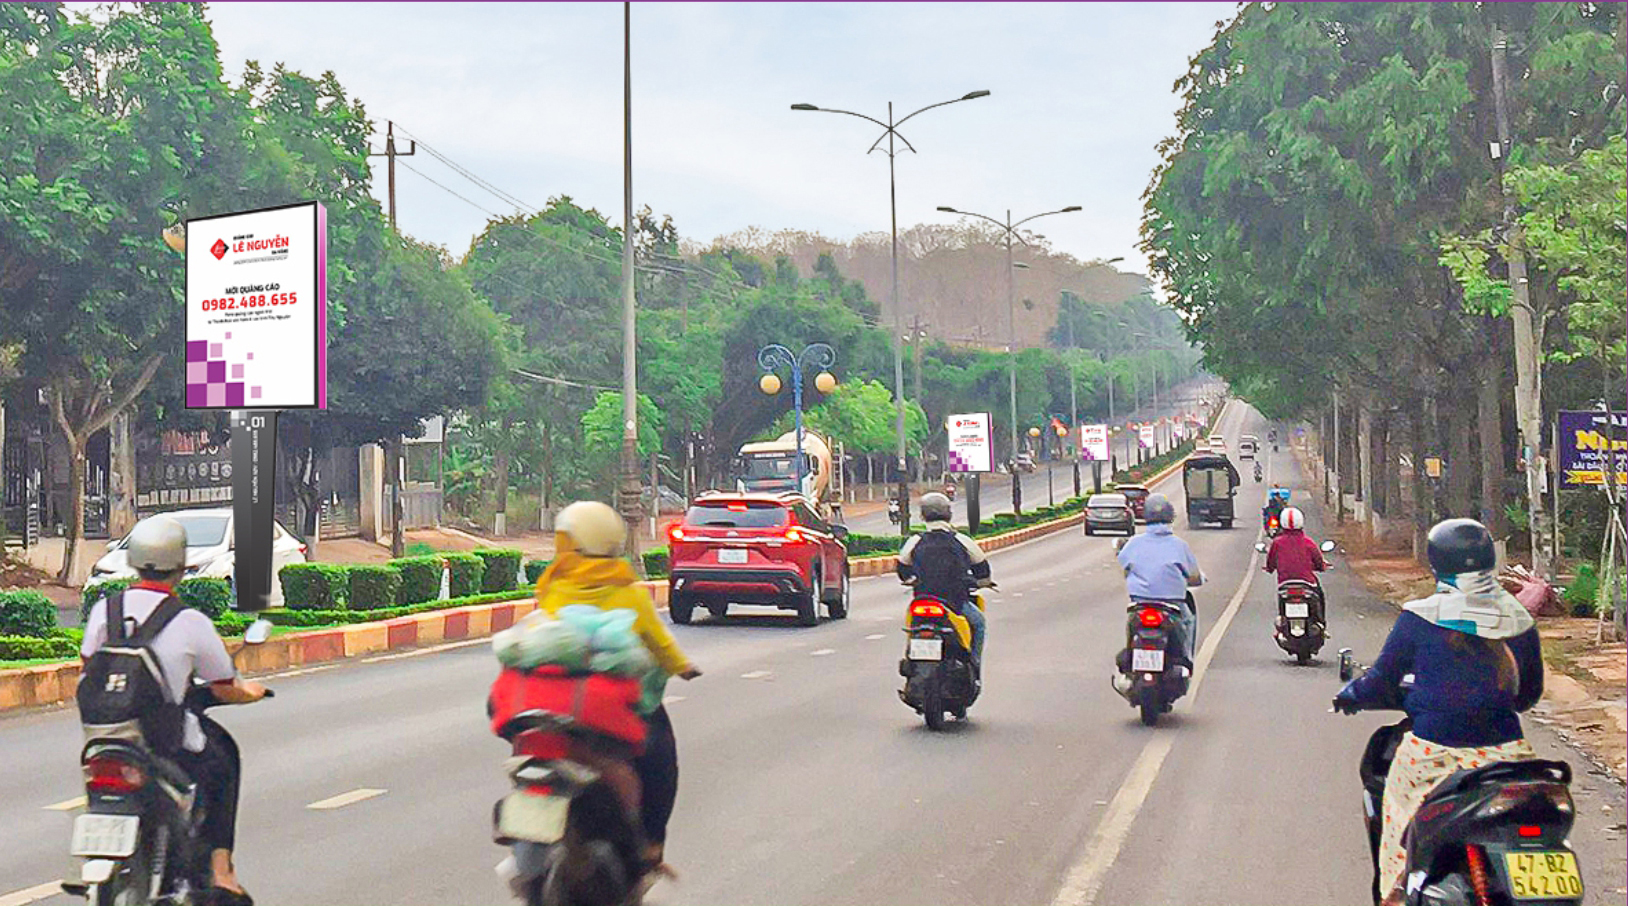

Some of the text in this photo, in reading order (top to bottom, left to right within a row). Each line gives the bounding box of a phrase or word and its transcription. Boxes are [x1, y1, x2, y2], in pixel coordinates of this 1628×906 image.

[233, 241, 244, 253] LÊ
[247, 234, 289, 251] NGUYỄN
[202, 292, 297, 311] 0982.488.655
[251, 416, 265, 428] 01
[1513, 875, 1580, 896] 542.00
